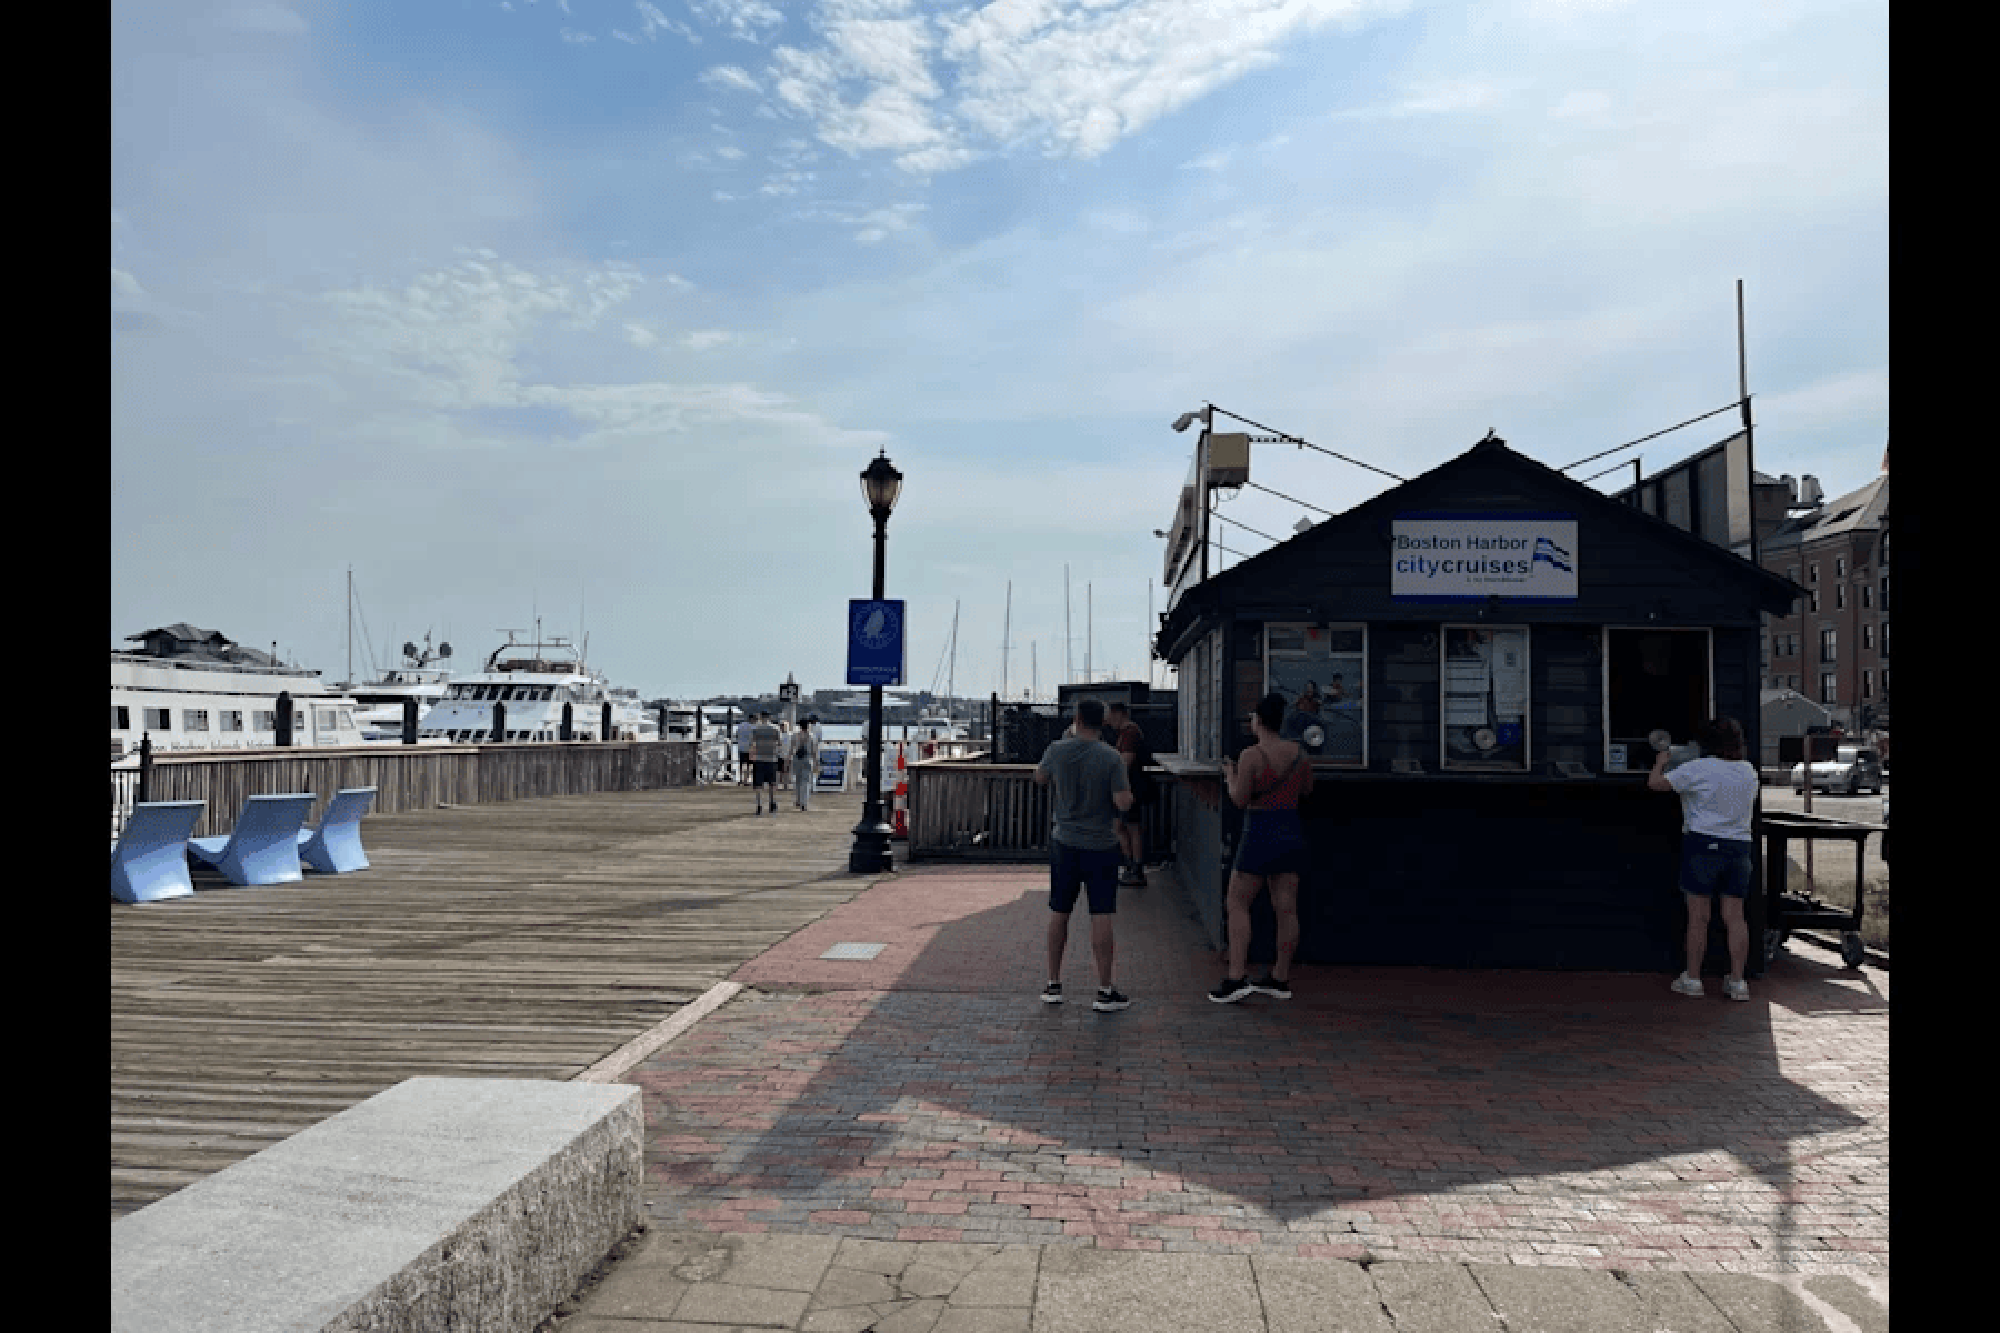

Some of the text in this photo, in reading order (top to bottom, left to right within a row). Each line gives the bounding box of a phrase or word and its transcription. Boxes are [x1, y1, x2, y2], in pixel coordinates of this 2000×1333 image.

[1396, 535, 1528, 550] Boston Harbor
[1396, 555, 1529, 578] citycruises
